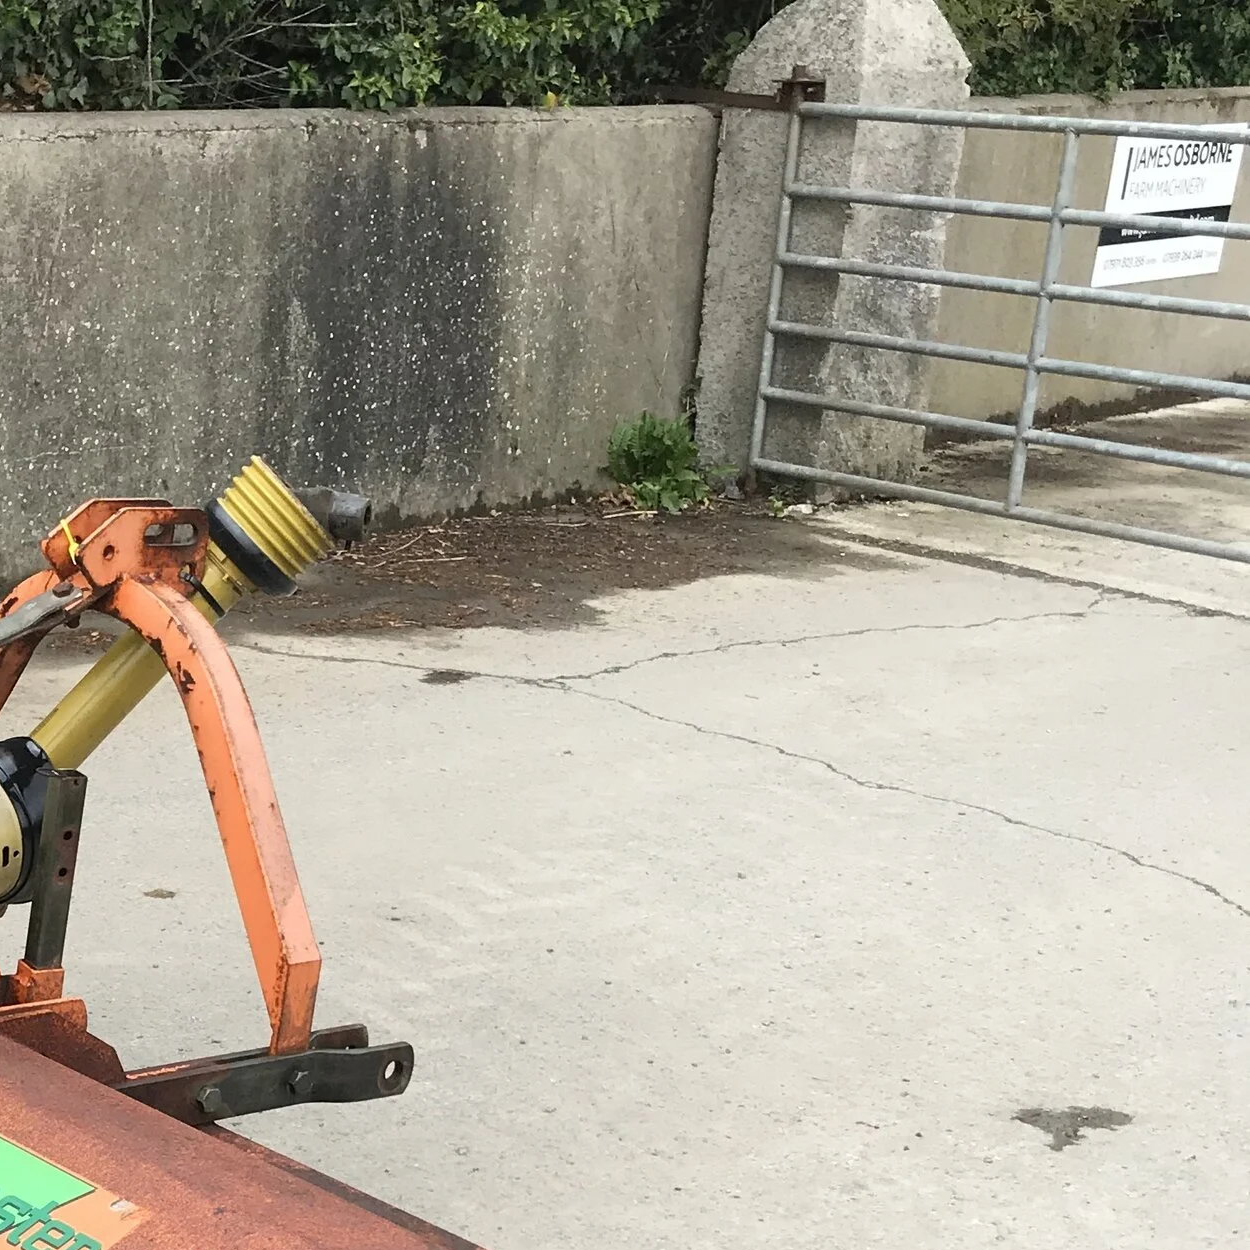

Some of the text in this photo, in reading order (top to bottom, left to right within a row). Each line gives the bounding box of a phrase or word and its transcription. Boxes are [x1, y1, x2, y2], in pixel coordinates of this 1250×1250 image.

[1133, 141, 1232, 172] JAMES OSBORNE
[1129, 176, 1207, 199] FARM MACHINERY
